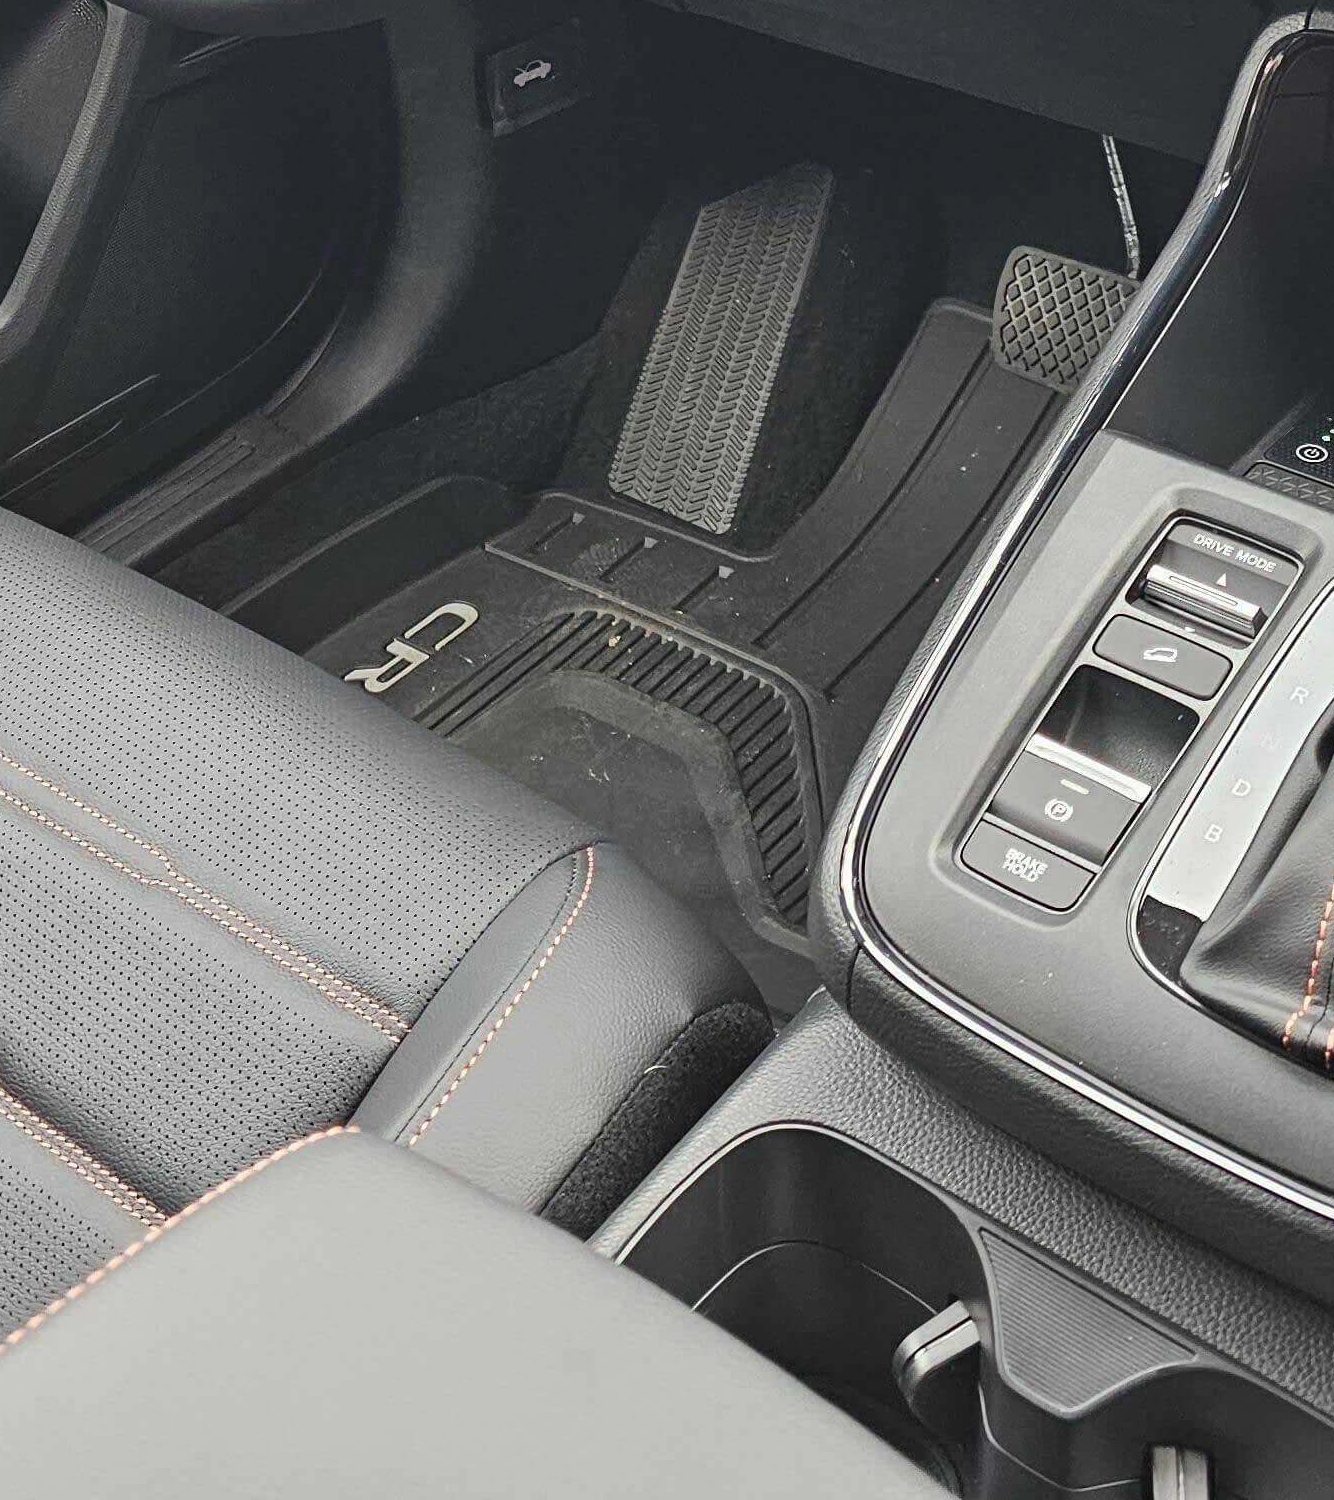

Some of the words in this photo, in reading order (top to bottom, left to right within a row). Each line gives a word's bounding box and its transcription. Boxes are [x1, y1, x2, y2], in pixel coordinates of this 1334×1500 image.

[1193, 533, 1235, 557] DRIVE
[1234, 549, 1277, 573] MODE
[1289, 686, 1309, 705] R
[1231, 778, 1252, 797] D
[1204, 823, 1223, 843] B
[1002, 859, 1039, 883] HOLD
[1005, 847, 1049, 875] BRAKE
